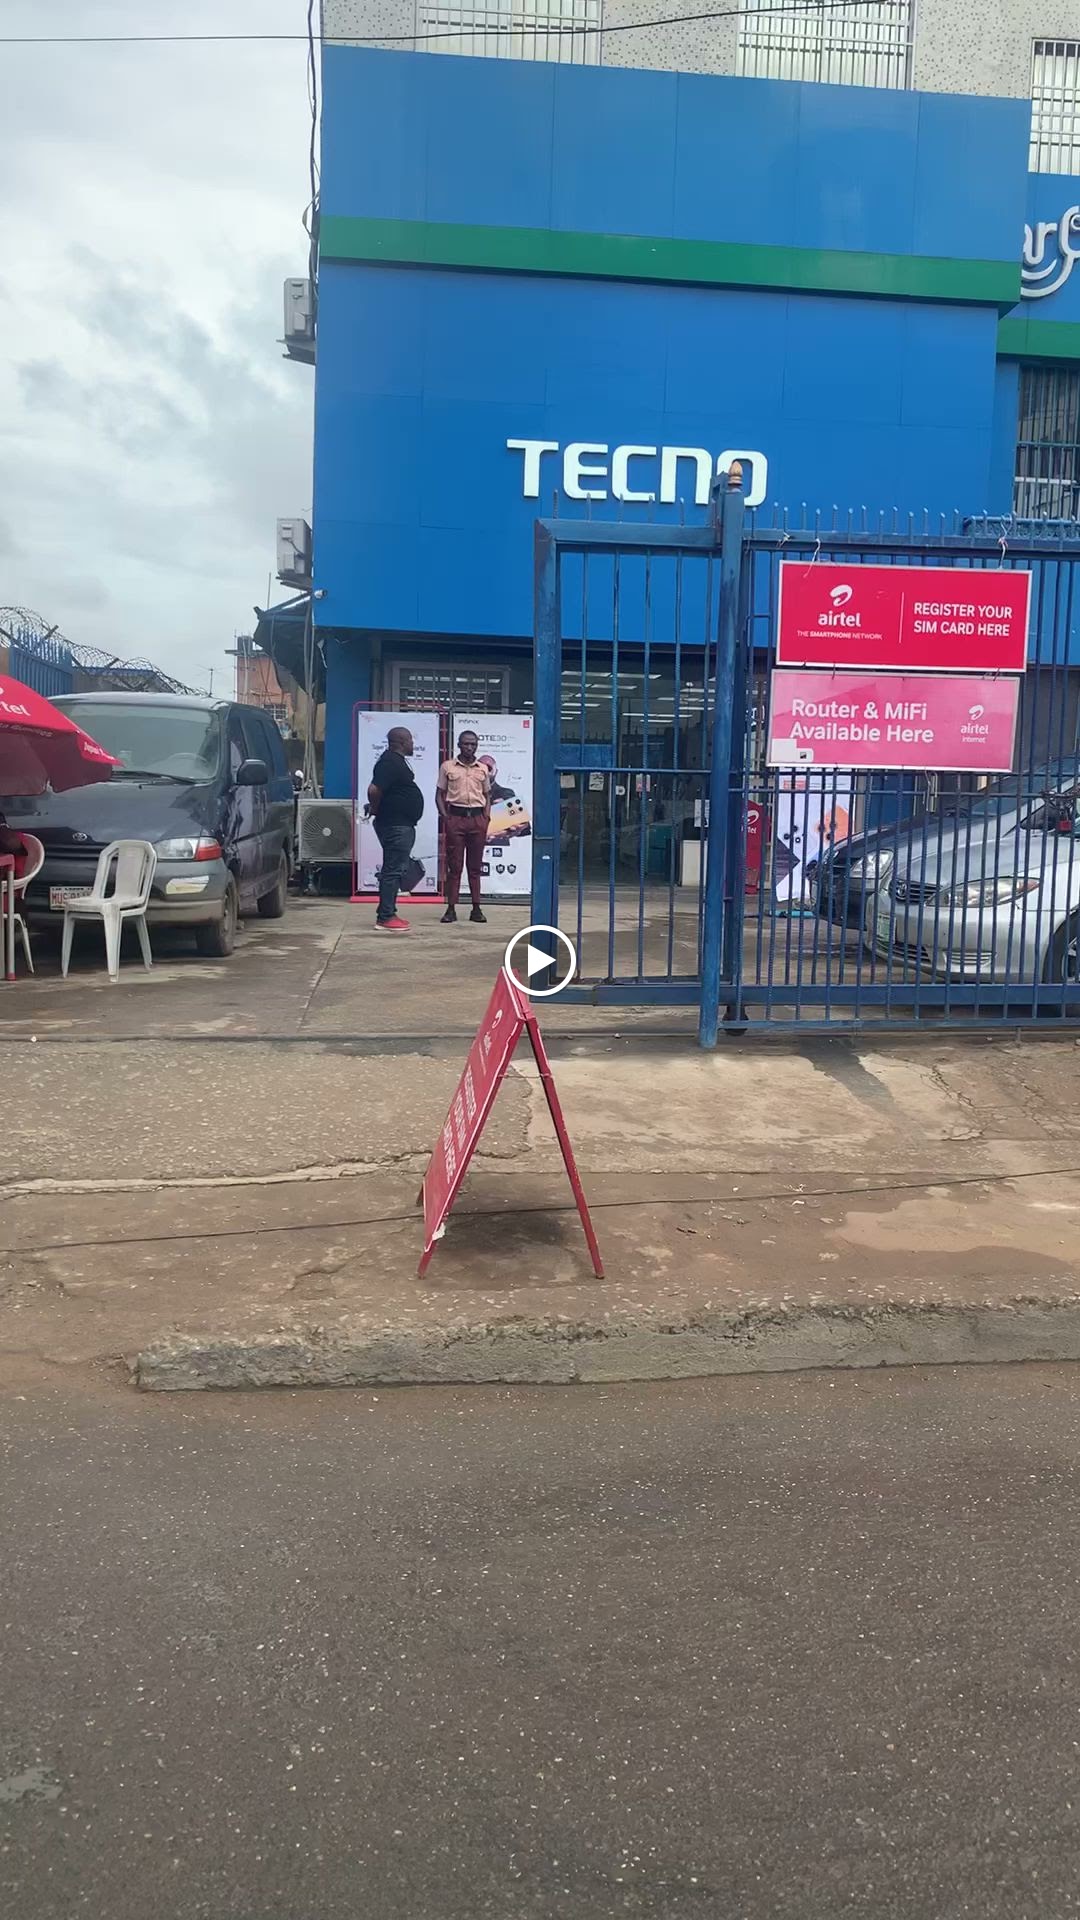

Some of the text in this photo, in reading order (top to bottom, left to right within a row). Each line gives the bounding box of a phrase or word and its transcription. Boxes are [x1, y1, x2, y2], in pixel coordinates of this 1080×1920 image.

[507, 439, 768, 506] TECNO
[818, 610, 861, 627] airtel
[914, 602, 1012, 619] REGISTER YOUR
[810, 631, 851, 639] SMARTPHONE
[914, 620, 1010, 636] SIM CARD HERE
[792, 699, 927, 720] Router & MiFi
[790, 722, 934, 742] Available Here
[960, 724, 989, 735] airtel
